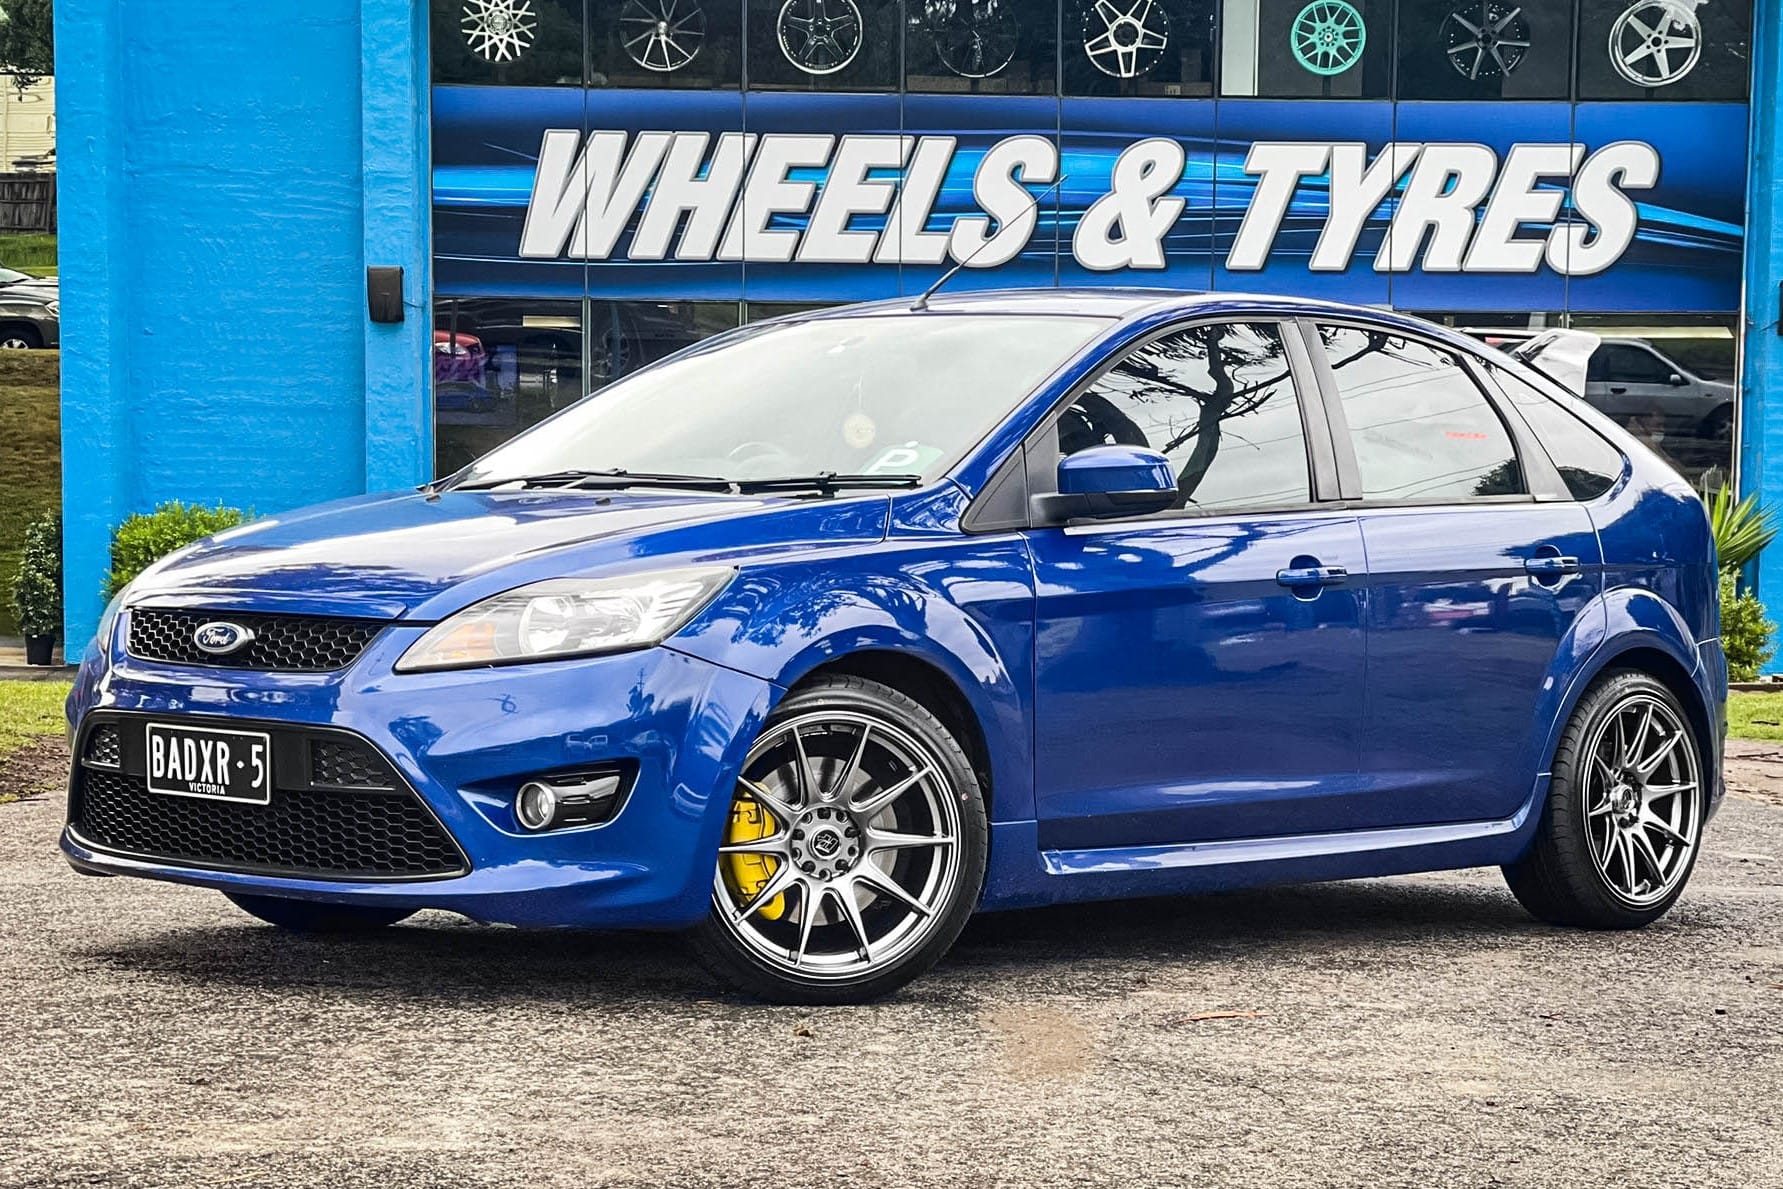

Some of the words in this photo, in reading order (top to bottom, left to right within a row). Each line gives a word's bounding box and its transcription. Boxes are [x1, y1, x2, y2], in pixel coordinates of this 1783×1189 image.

[519, 129, 1057, 268] WHEELS
[1072, 137, 1185, 271] &
[1225, 140, 1659, 275] TYRES
[201, 627, 231, 645] Ford
[188, 782, 226, 795] VICTORIA
